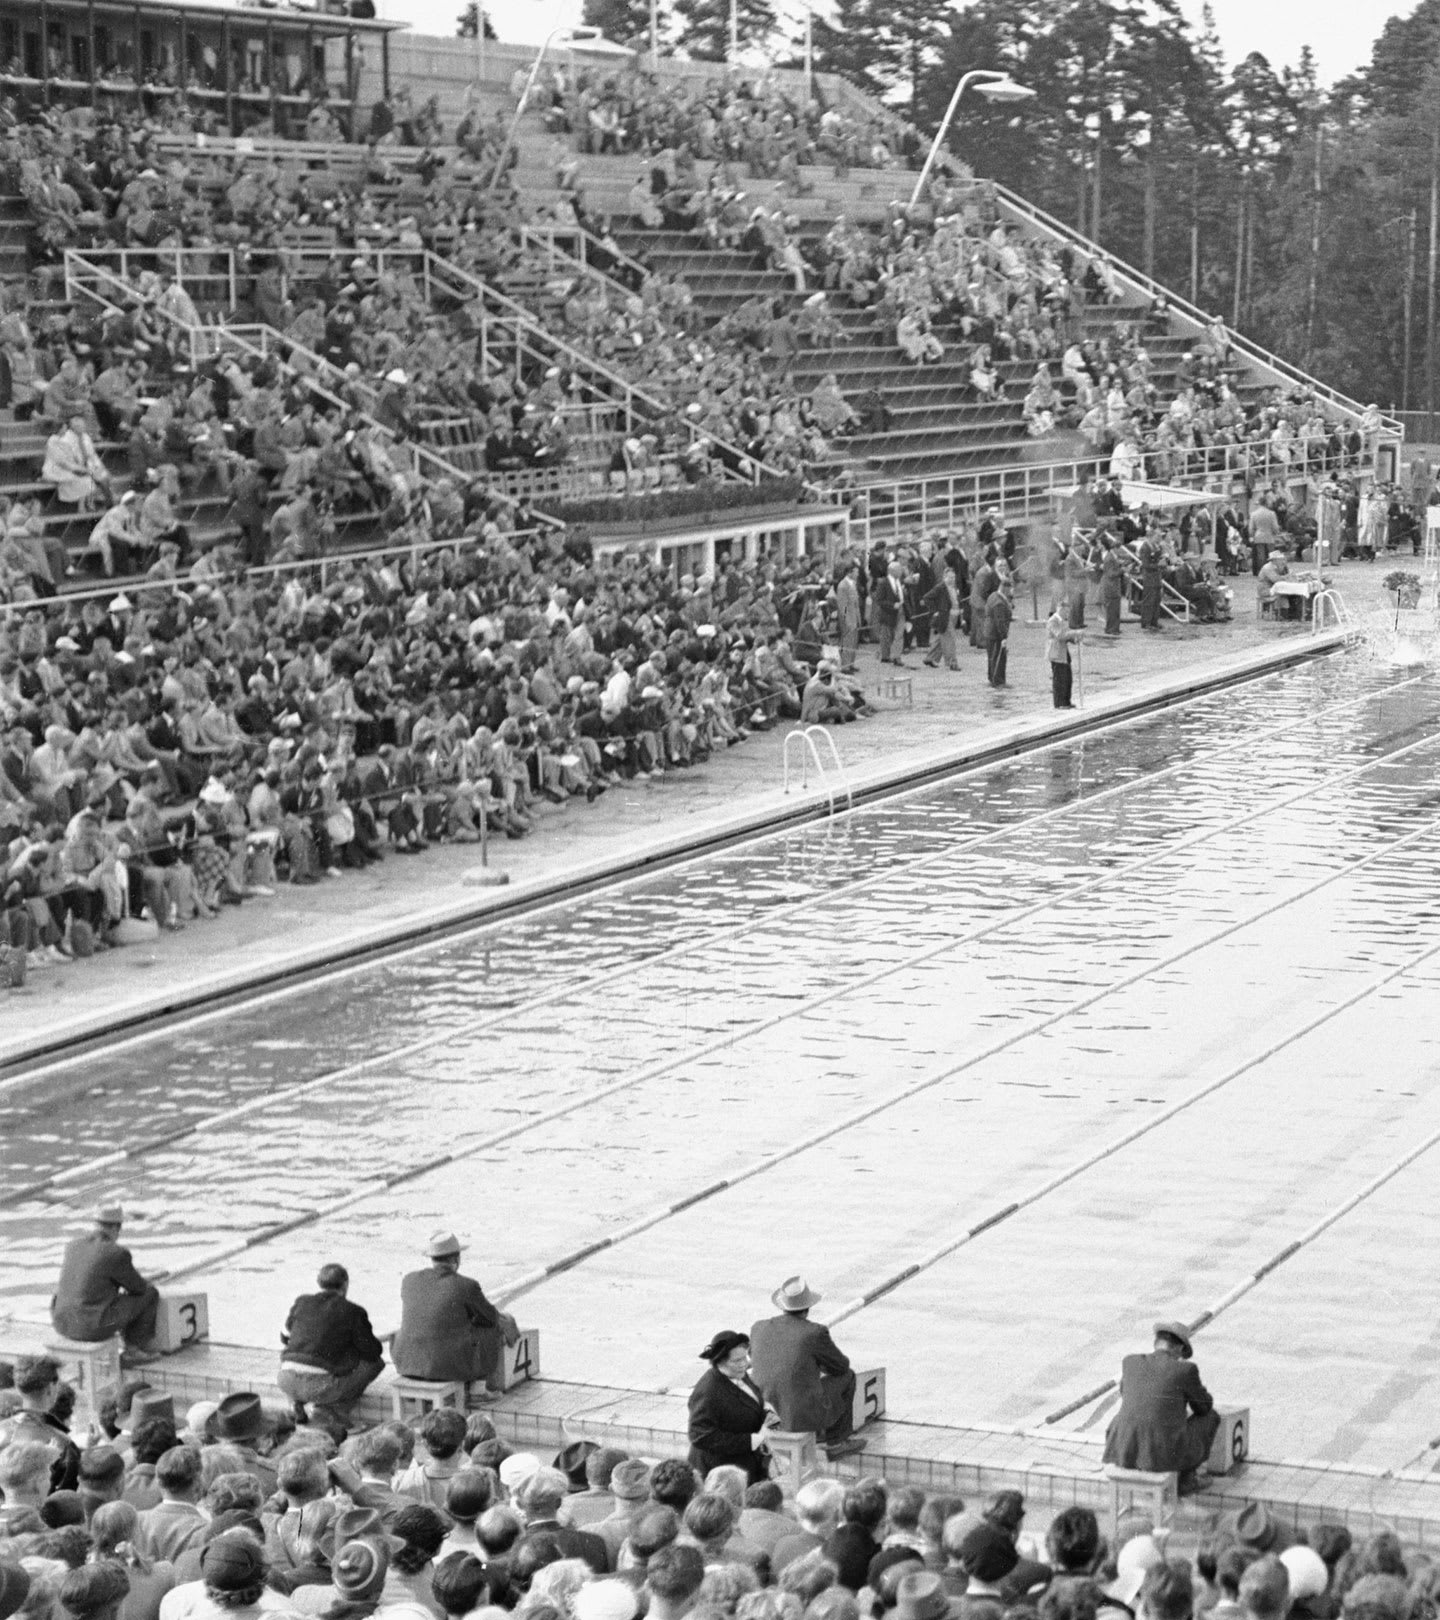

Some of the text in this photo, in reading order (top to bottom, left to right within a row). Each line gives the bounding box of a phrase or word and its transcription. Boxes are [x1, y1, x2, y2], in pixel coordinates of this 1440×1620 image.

[179, 1303, 197, 1344] 3
[513, 1338, 531, 1379] 4
[865, 1376, 878, 1424] 5
[1232, 1420, 1243, 1463] 6
